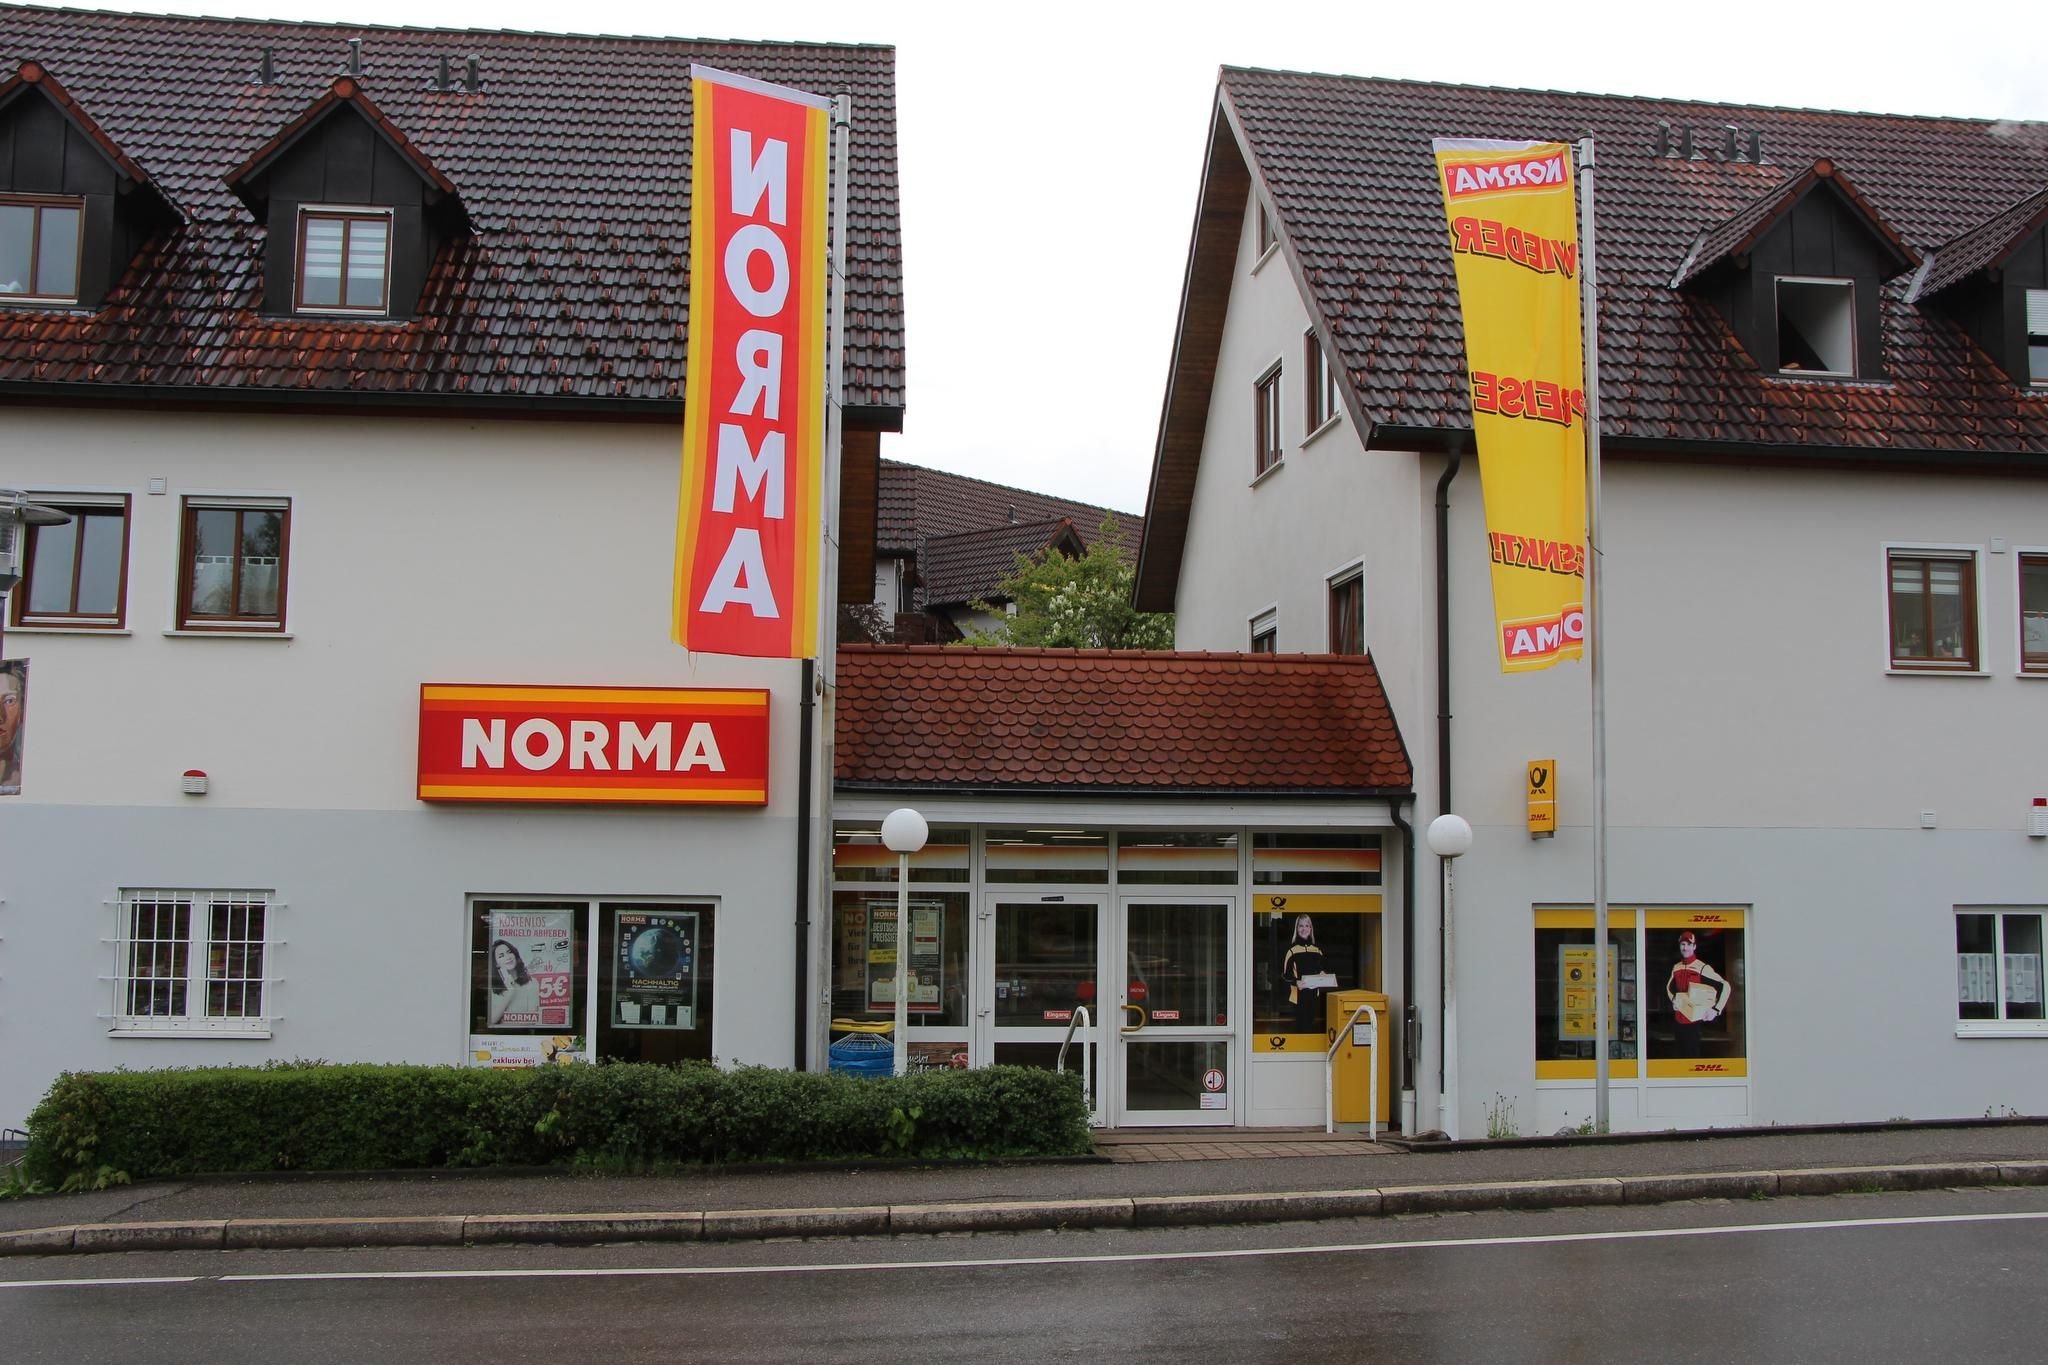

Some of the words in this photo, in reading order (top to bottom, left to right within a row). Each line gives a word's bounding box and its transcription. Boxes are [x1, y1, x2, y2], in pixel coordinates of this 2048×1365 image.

[461, 718, 726, 772] NORMA
[1529, 813, 1550, 821] DHL
[499, 916, 546, 928] KOSTENLOS
[499, 929, 532, 937] BARGELD
[533, 929, 567, 938] ABHEBEN
[540, 975, 568, 998] 5€
[503, 1013, 538, 1021] NORMA
[493, 1056, 521, 1064] exklusiv
[523, 1056, 535, 1064] bei
